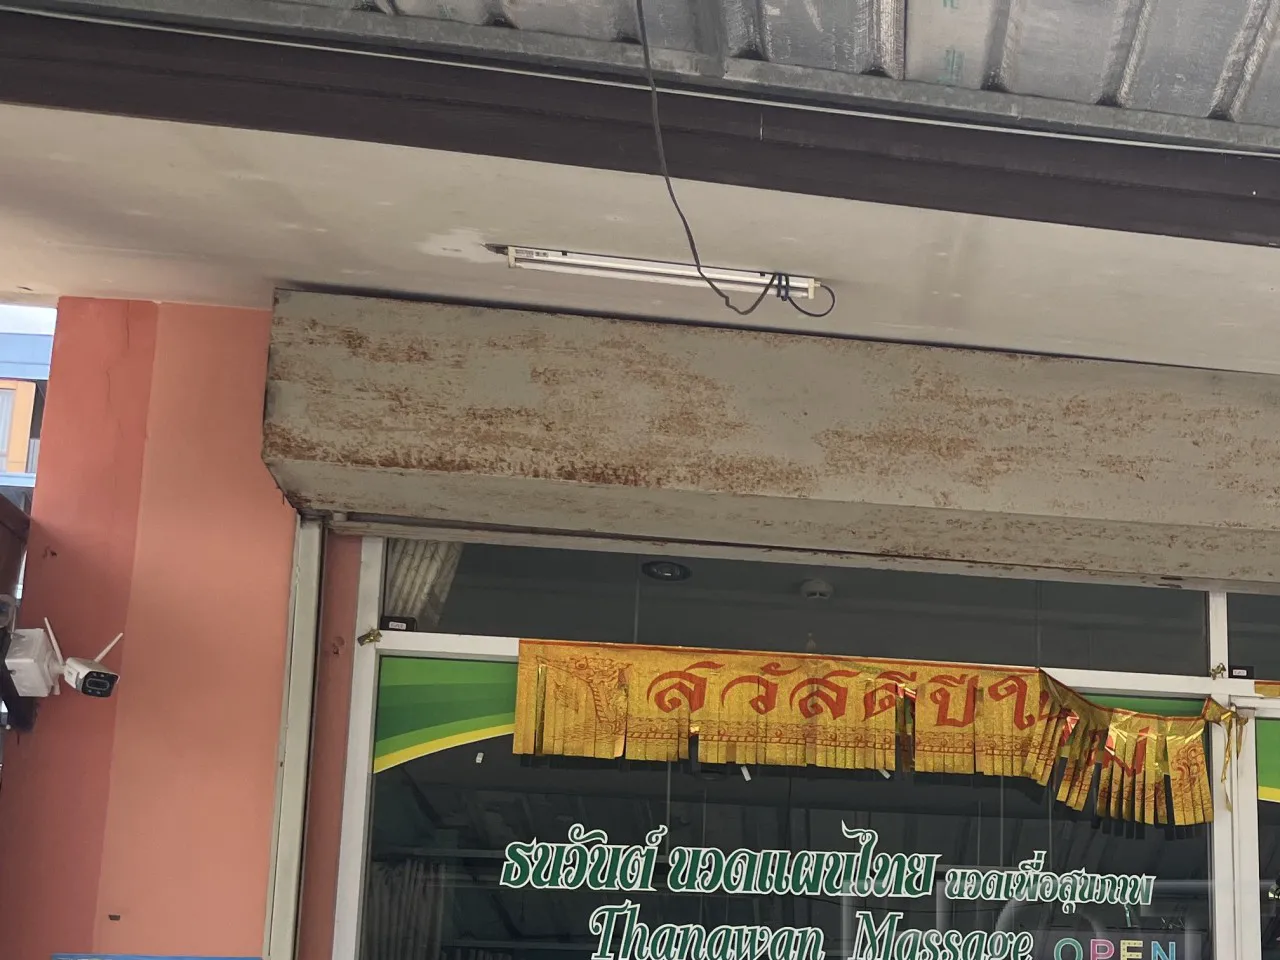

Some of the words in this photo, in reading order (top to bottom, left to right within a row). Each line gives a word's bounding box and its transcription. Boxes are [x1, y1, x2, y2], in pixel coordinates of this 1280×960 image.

[500, 823, 668, 892] ธนวันต์
[667, 819, 942, 896] นวดแผนไทย
[944, 850, 1157, 914] นวดเพื่อสุขภาพ
